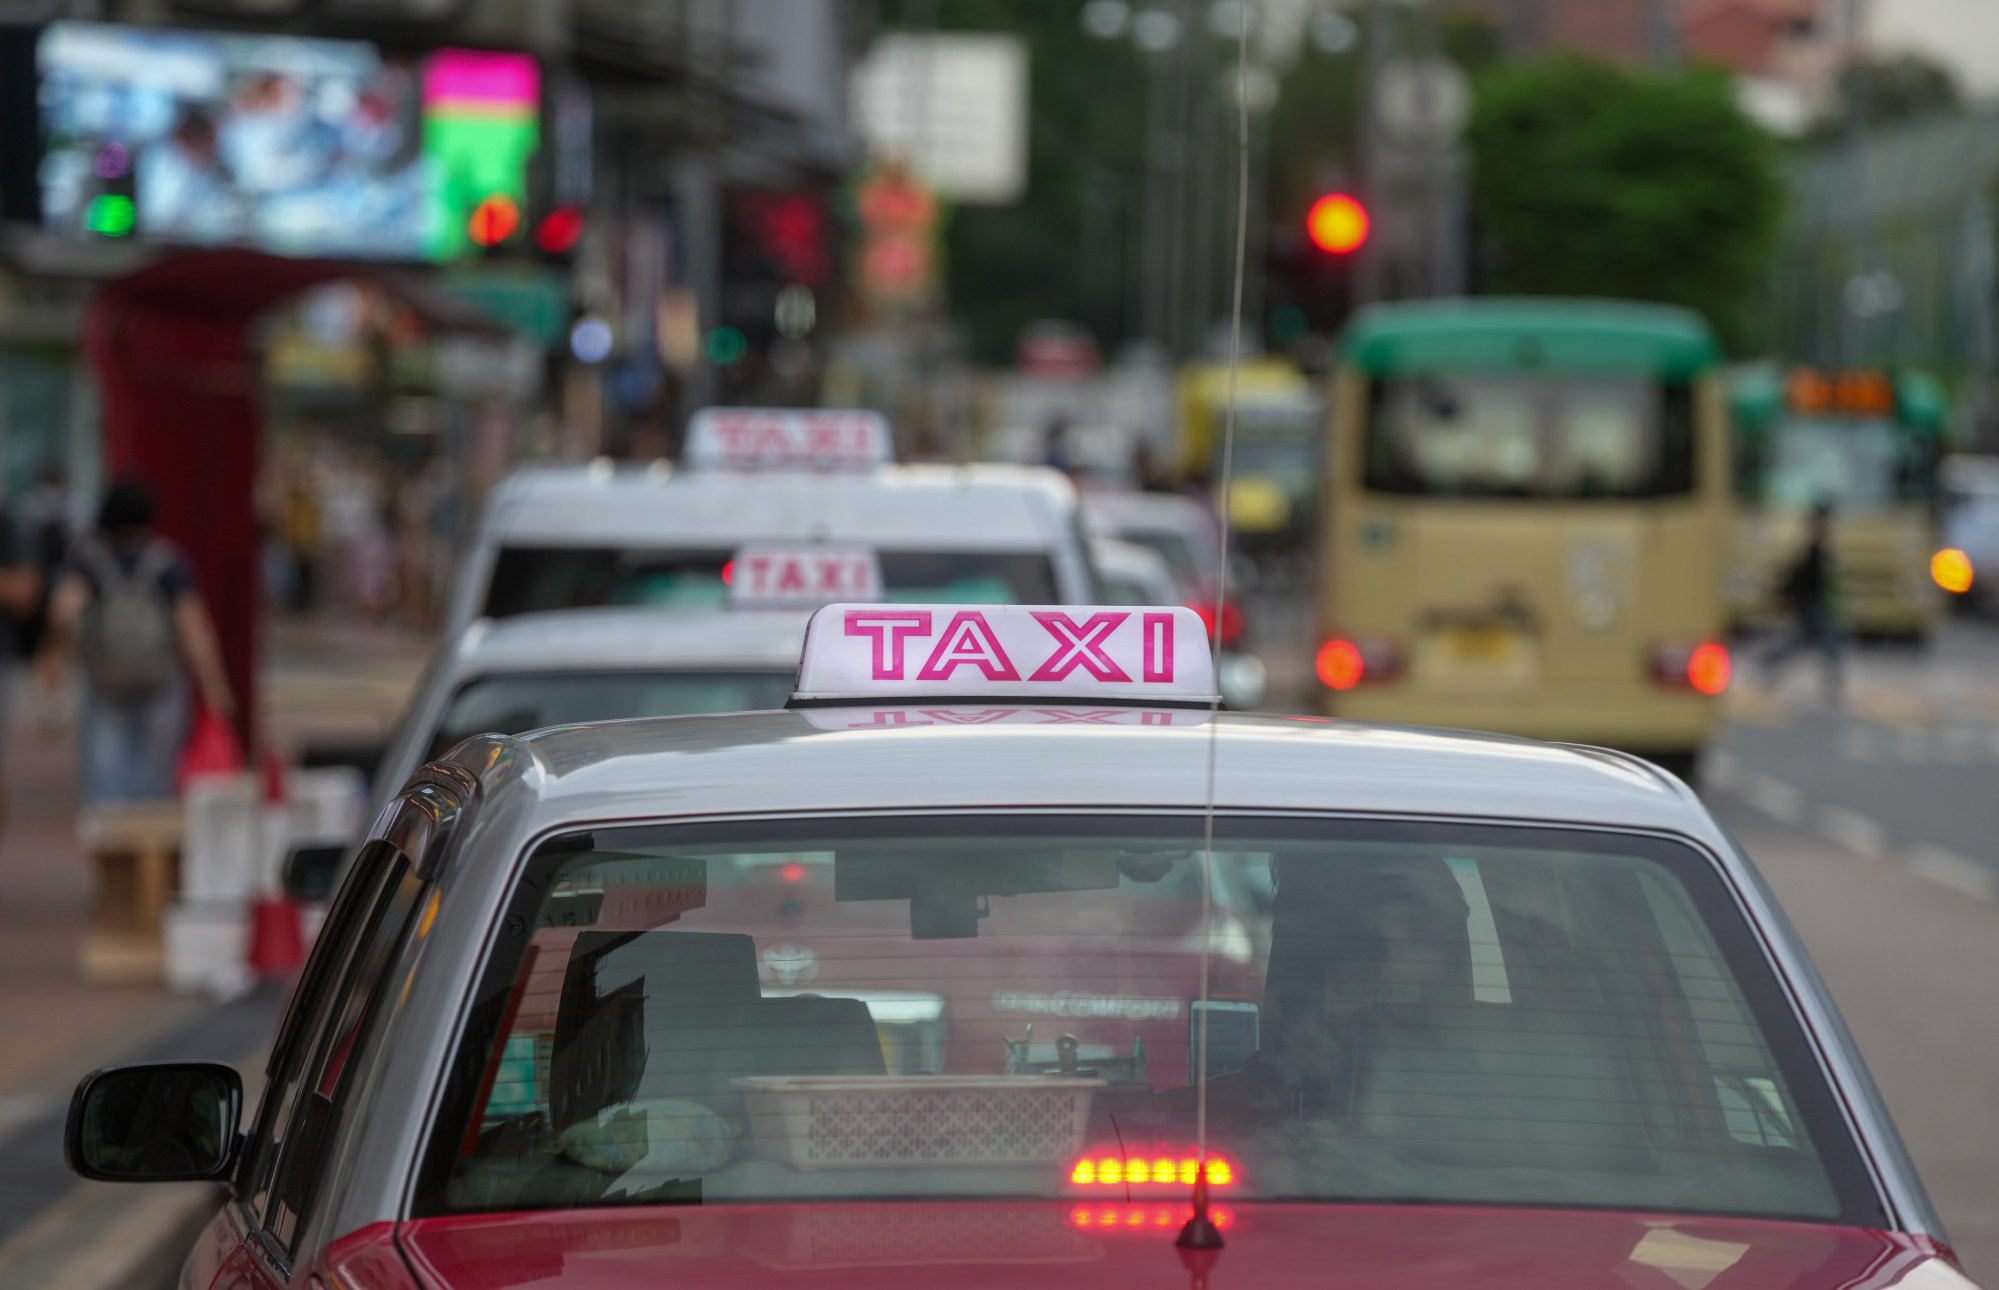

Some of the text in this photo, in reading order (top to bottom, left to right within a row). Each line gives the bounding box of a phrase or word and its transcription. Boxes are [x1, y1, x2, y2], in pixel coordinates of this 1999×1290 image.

[711, 413, 873, 460] TAXI
[747, 556, 870, 596] TAXI
[844, 610, 1174, 683] TAXI
